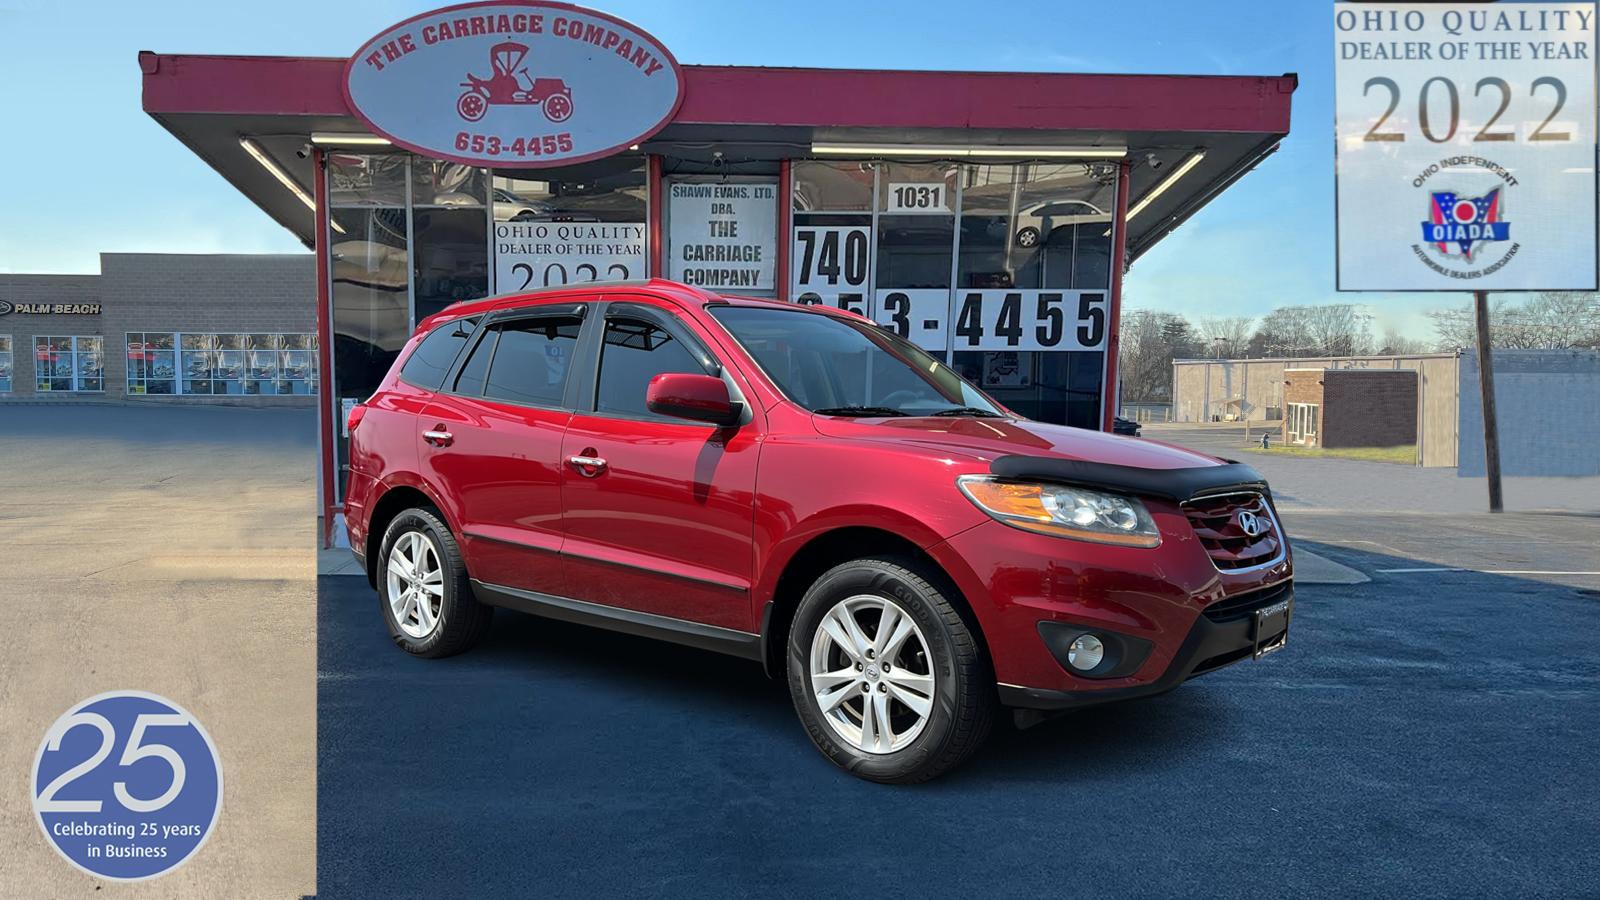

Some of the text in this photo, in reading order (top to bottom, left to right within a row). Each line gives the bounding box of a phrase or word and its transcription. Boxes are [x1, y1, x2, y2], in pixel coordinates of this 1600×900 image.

[1336, 10, 1592, 36] OHIO QUALITY
[366, 14, 664, 77] THE CARRIAGE COMPANY
[1340, 42, 1589, 60] DEALER OF THE YEAR
[1363, 76, 1571, 144] 2022
[455, 131, 573, 156] 653-4455
[1412, 155, 1519, 188] OHIO INDEPENDENT
[672, 186, 712, 199] SHAWN
[754, 187, 775, 200] LTD.
[894, 187, 941, 208] 1031
[711, 203, 736, 215] DBA.
[497, 226, 644, 241] OHIO QUALITY
[708, 220, 738, 238] THE
[1433, 224, 1495, 240] OIADA
[499, 244, 642, 255] DEALER OF THE YEAR
[683, 245, 762, 262] CARRIAGE
[797, 230, 868, 286] 740
[1411, 242, 1521, 279] AUTOMOBILE DEALERS ASSOCIATION
[683, 268, 760, 286] COMPANY
[15, 303, 100, 314] PALM BEACH
